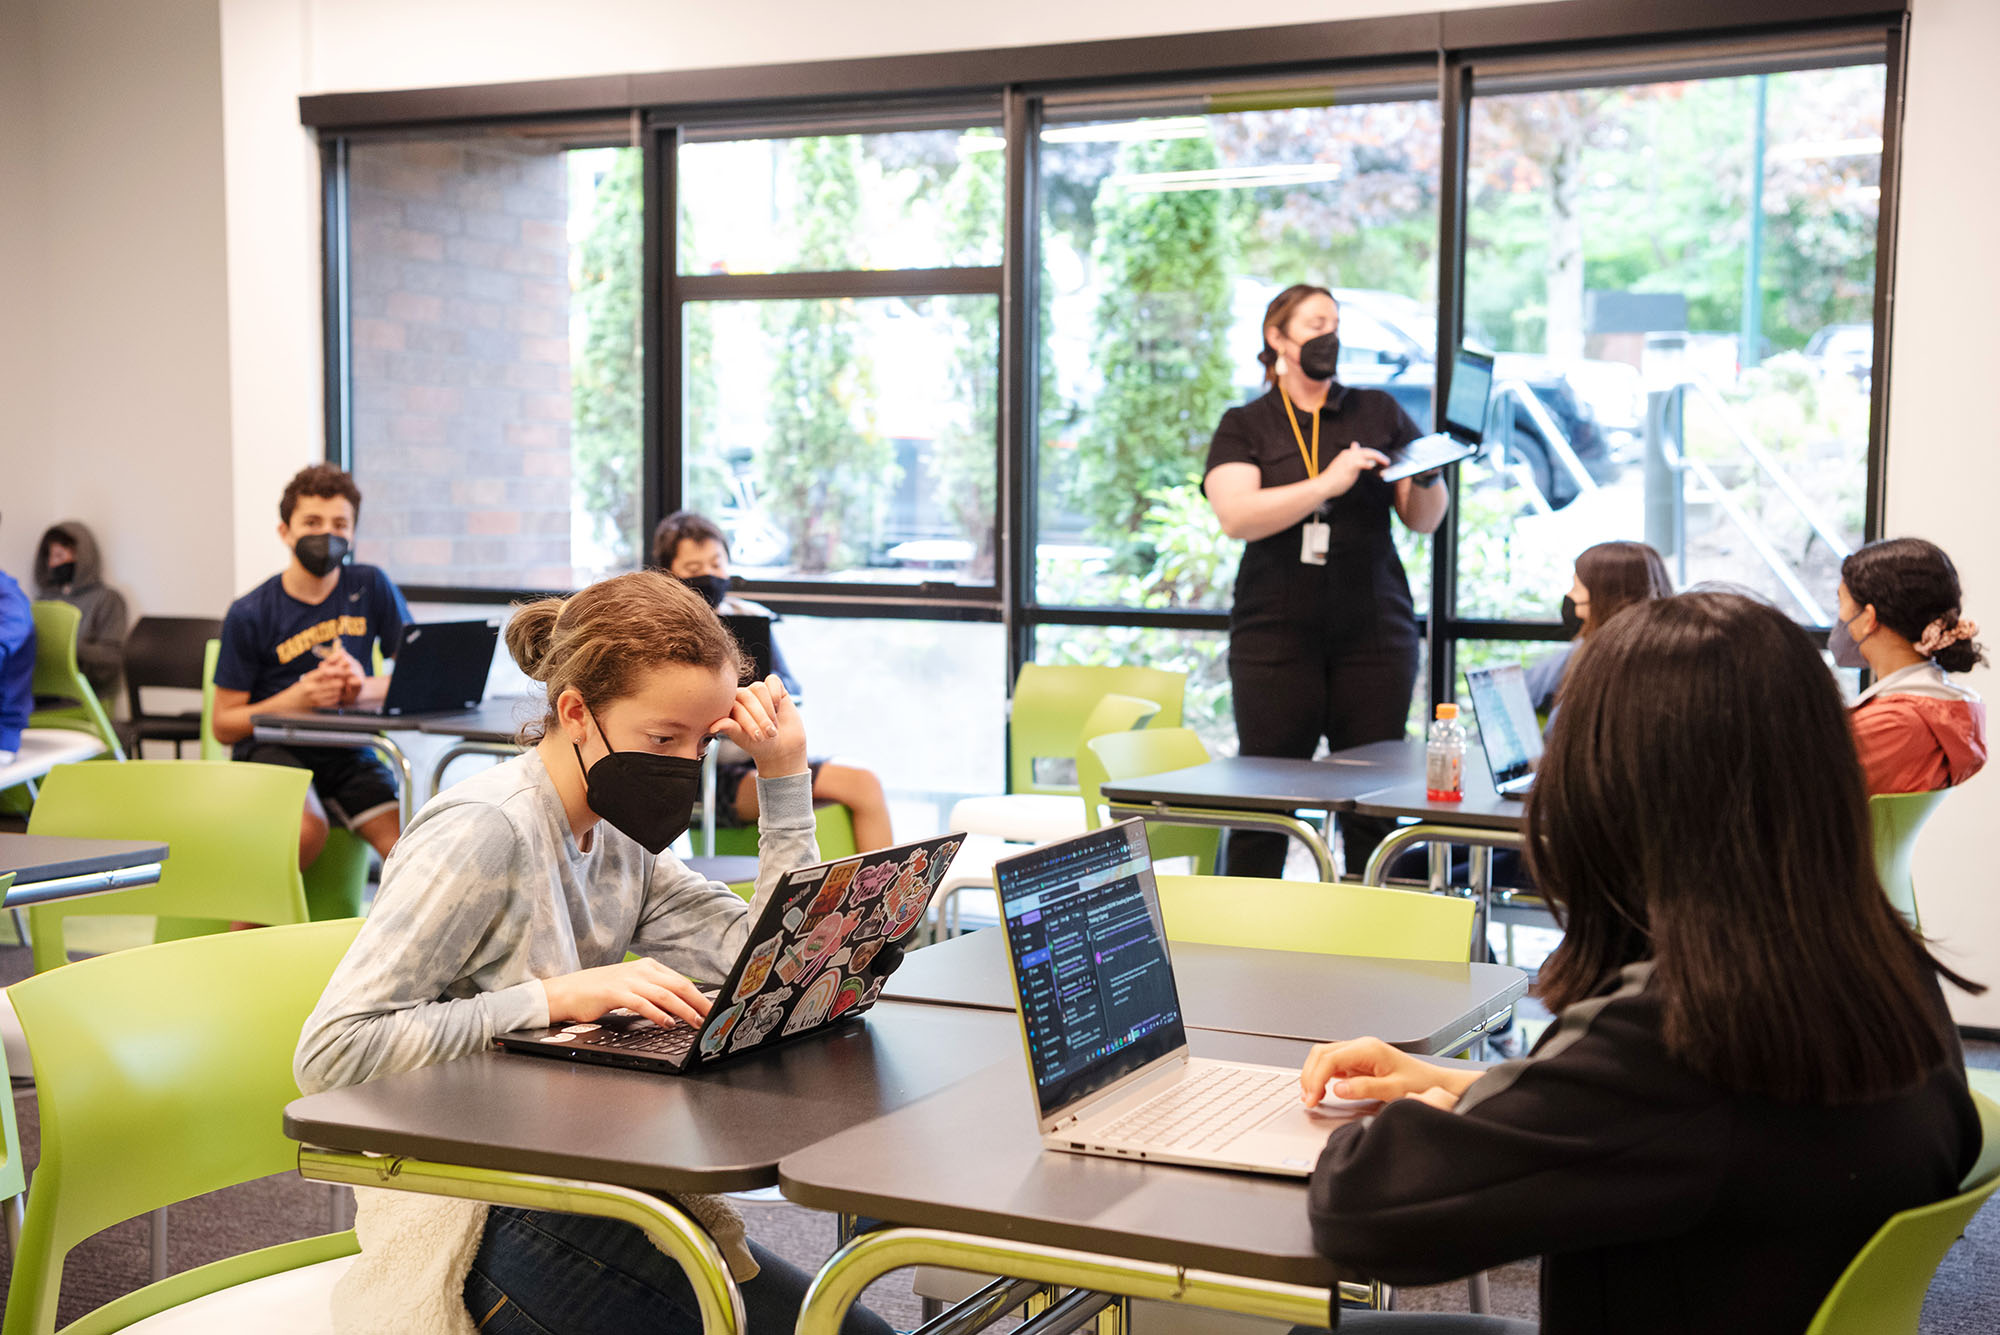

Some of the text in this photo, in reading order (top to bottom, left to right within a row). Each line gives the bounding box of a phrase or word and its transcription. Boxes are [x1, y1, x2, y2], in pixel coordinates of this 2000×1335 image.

[829, 865, 856, 882] LET'S
[784, 1008, 827, 1034] be kind
